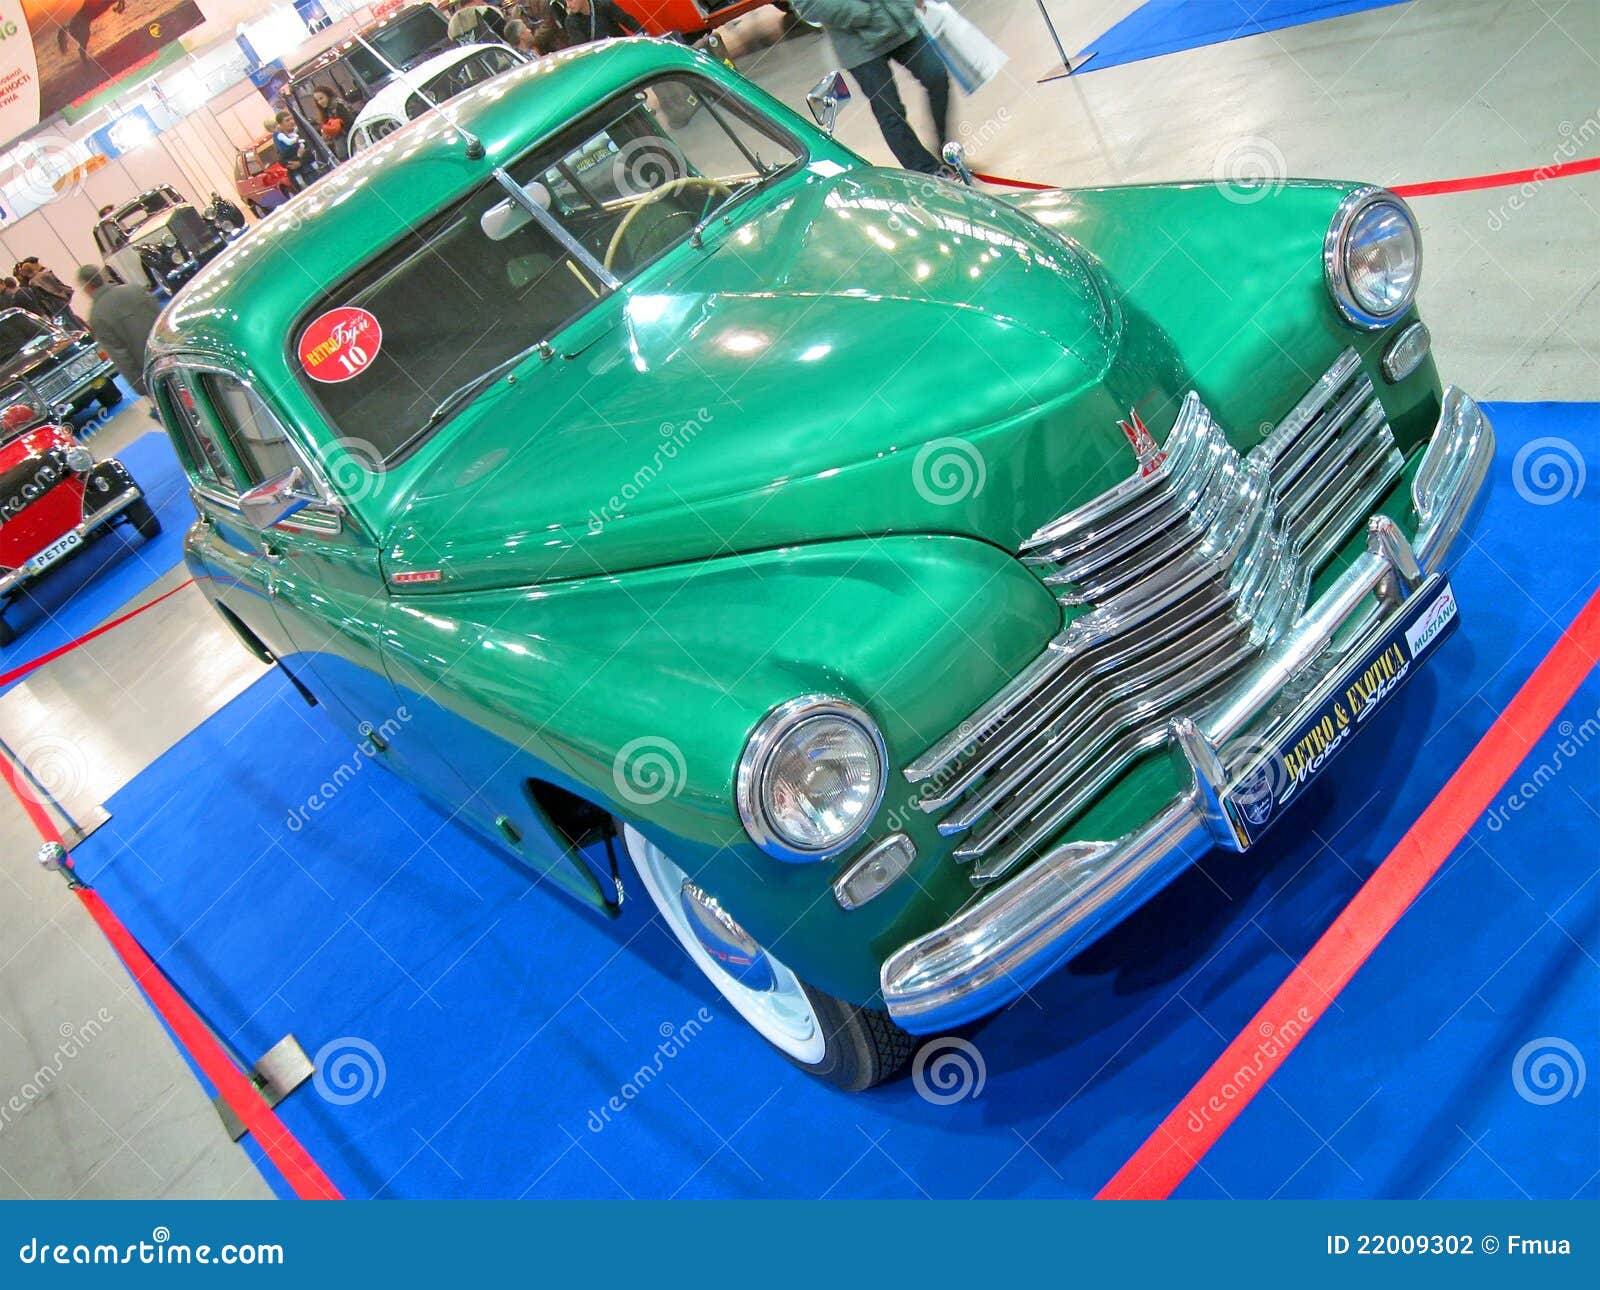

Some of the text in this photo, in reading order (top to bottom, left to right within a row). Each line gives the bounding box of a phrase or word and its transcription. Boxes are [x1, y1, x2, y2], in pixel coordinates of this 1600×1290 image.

[338, 346, 368, 374] 10
[1414, 600, 1455, 652] MUSTANG
[1279, 660, 1411, 805] Motor Show
[1283, 642, 1405, 781] RETRO & EXOTICA
